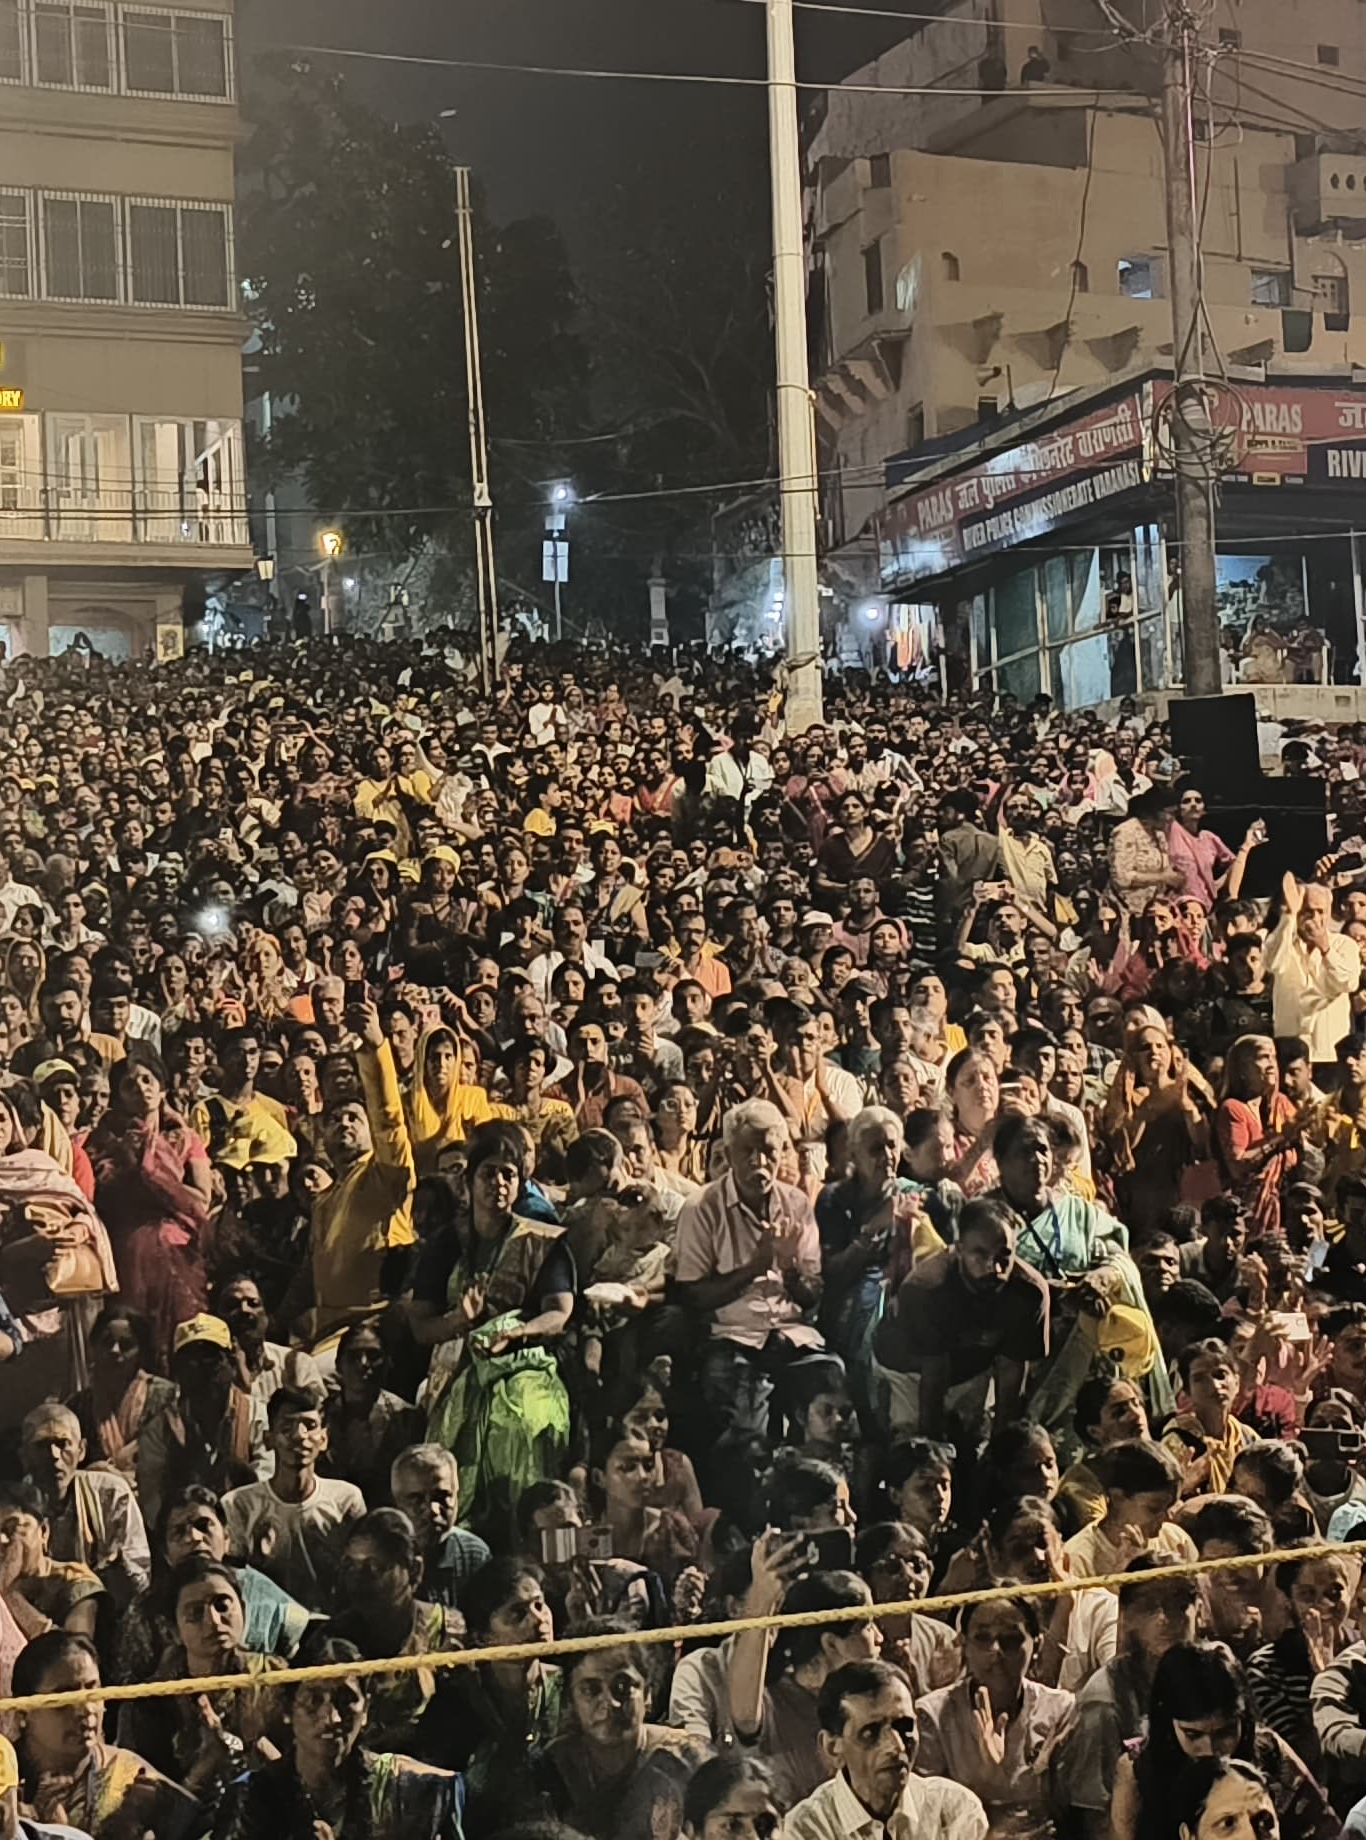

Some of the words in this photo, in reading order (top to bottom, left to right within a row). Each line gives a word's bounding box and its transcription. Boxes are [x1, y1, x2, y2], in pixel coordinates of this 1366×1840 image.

[1241, 402, 1303, 433] PARAS
[954, 477, 980, 511] जल
[1092, 461, 1141, 501] VARANASI
[916, 486, 955, 533] PARAS
